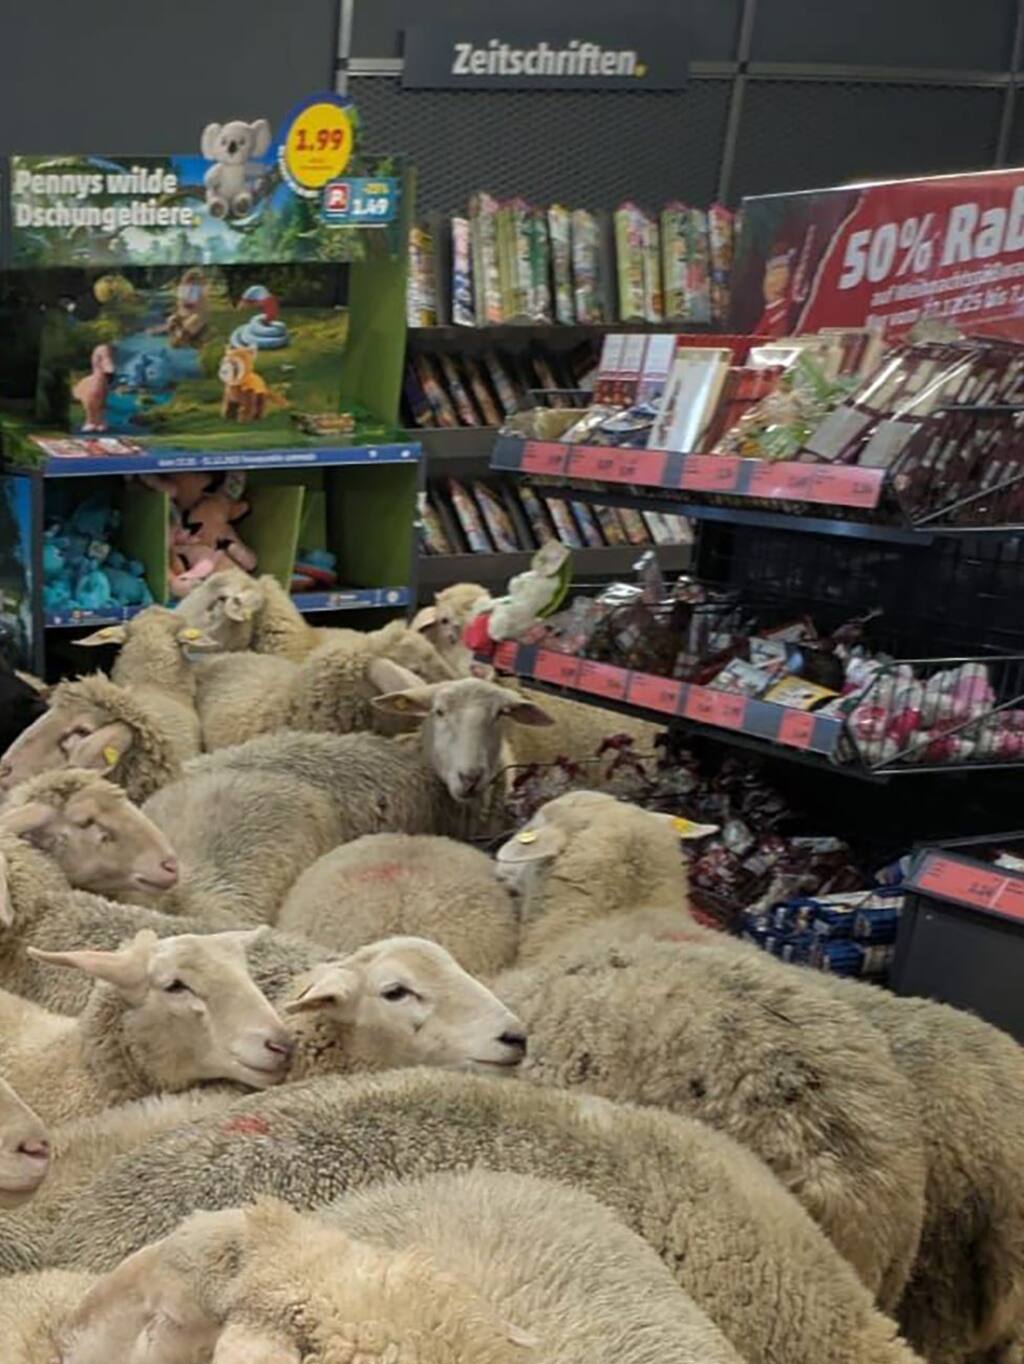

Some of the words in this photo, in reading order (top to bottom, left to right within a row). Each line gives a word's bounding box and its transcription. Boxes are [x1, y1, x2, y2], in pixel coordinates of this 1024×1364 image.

[451, 39, 647, 77] Zeitschriften.
[295, 128, 344, 150] 1.99
[15, 169, 103, 199] Pennys
[105, 165, 178, 194] wilde
[837, 213, 936, 290] 50%
